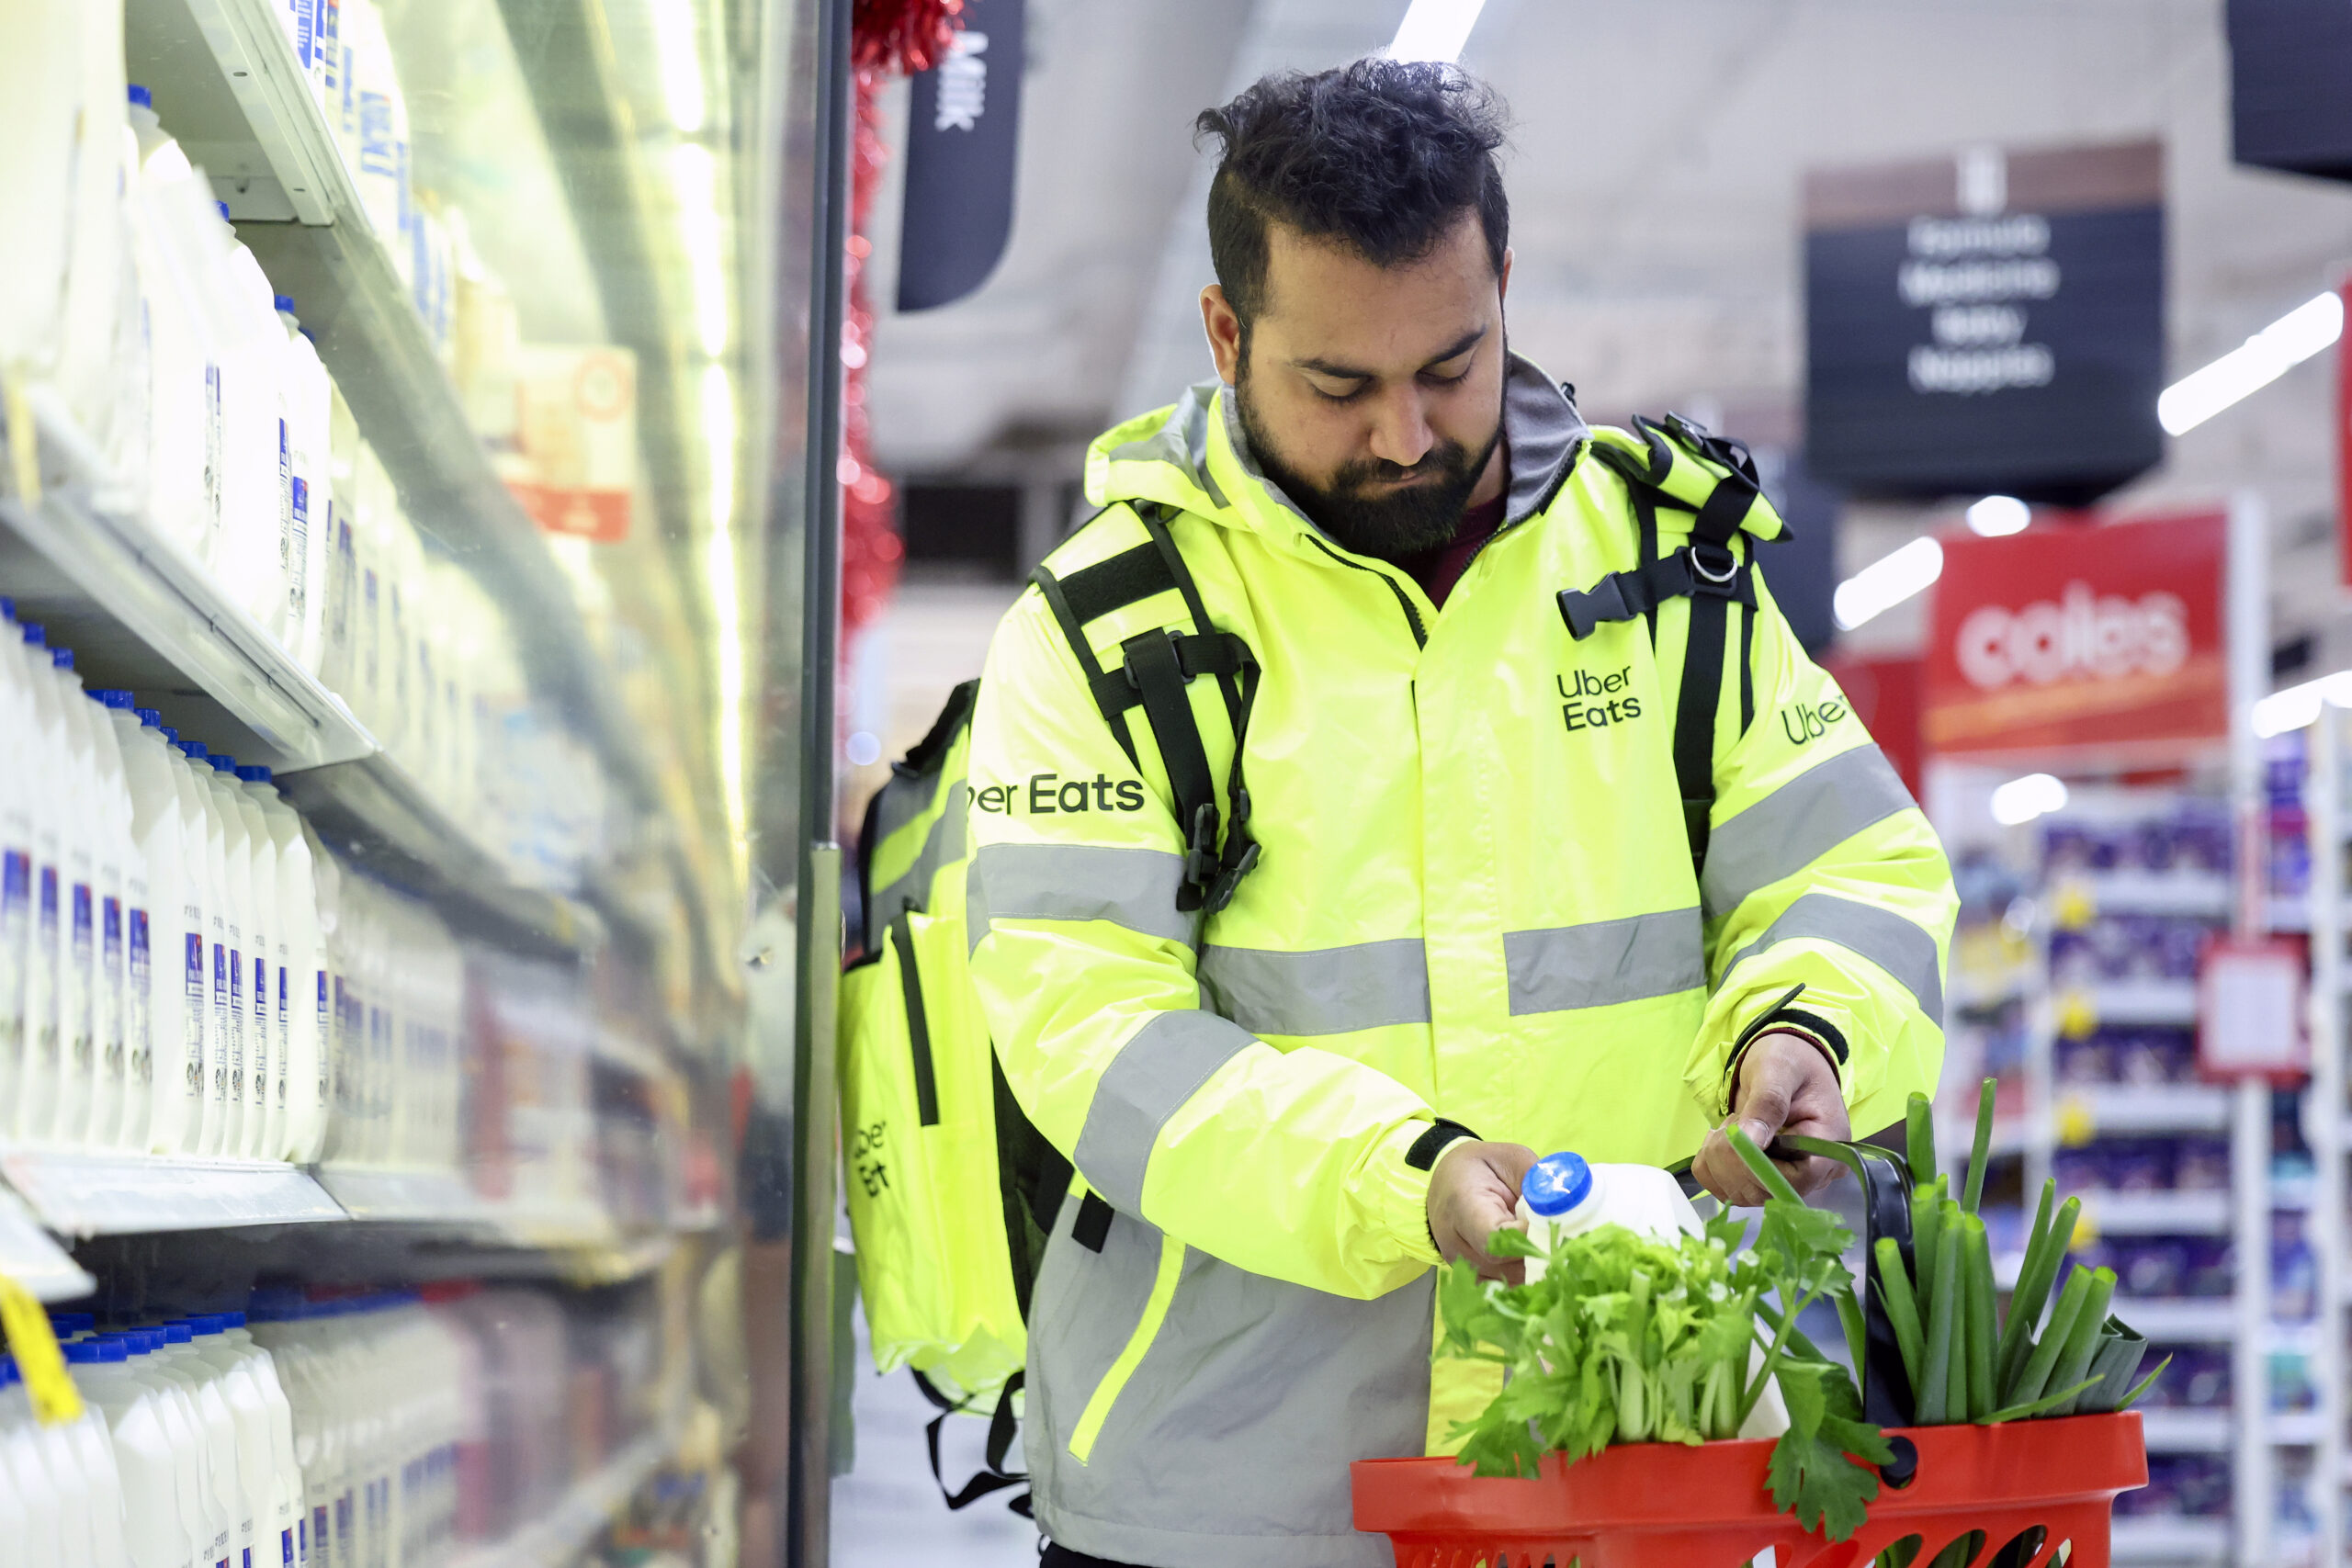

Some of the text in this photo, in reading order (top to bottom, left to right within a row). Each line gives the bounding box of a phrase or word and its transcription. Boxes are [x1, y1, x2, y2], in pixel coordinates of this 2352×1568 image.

[935, 30, 989, 132] Milk
[1956, 580, 2189, 687] coles
[1556, 665, 1631, 698] Uber
[1562, 697, 1641, 731] Eats
[967, 773, 1145, 816] er Eats
